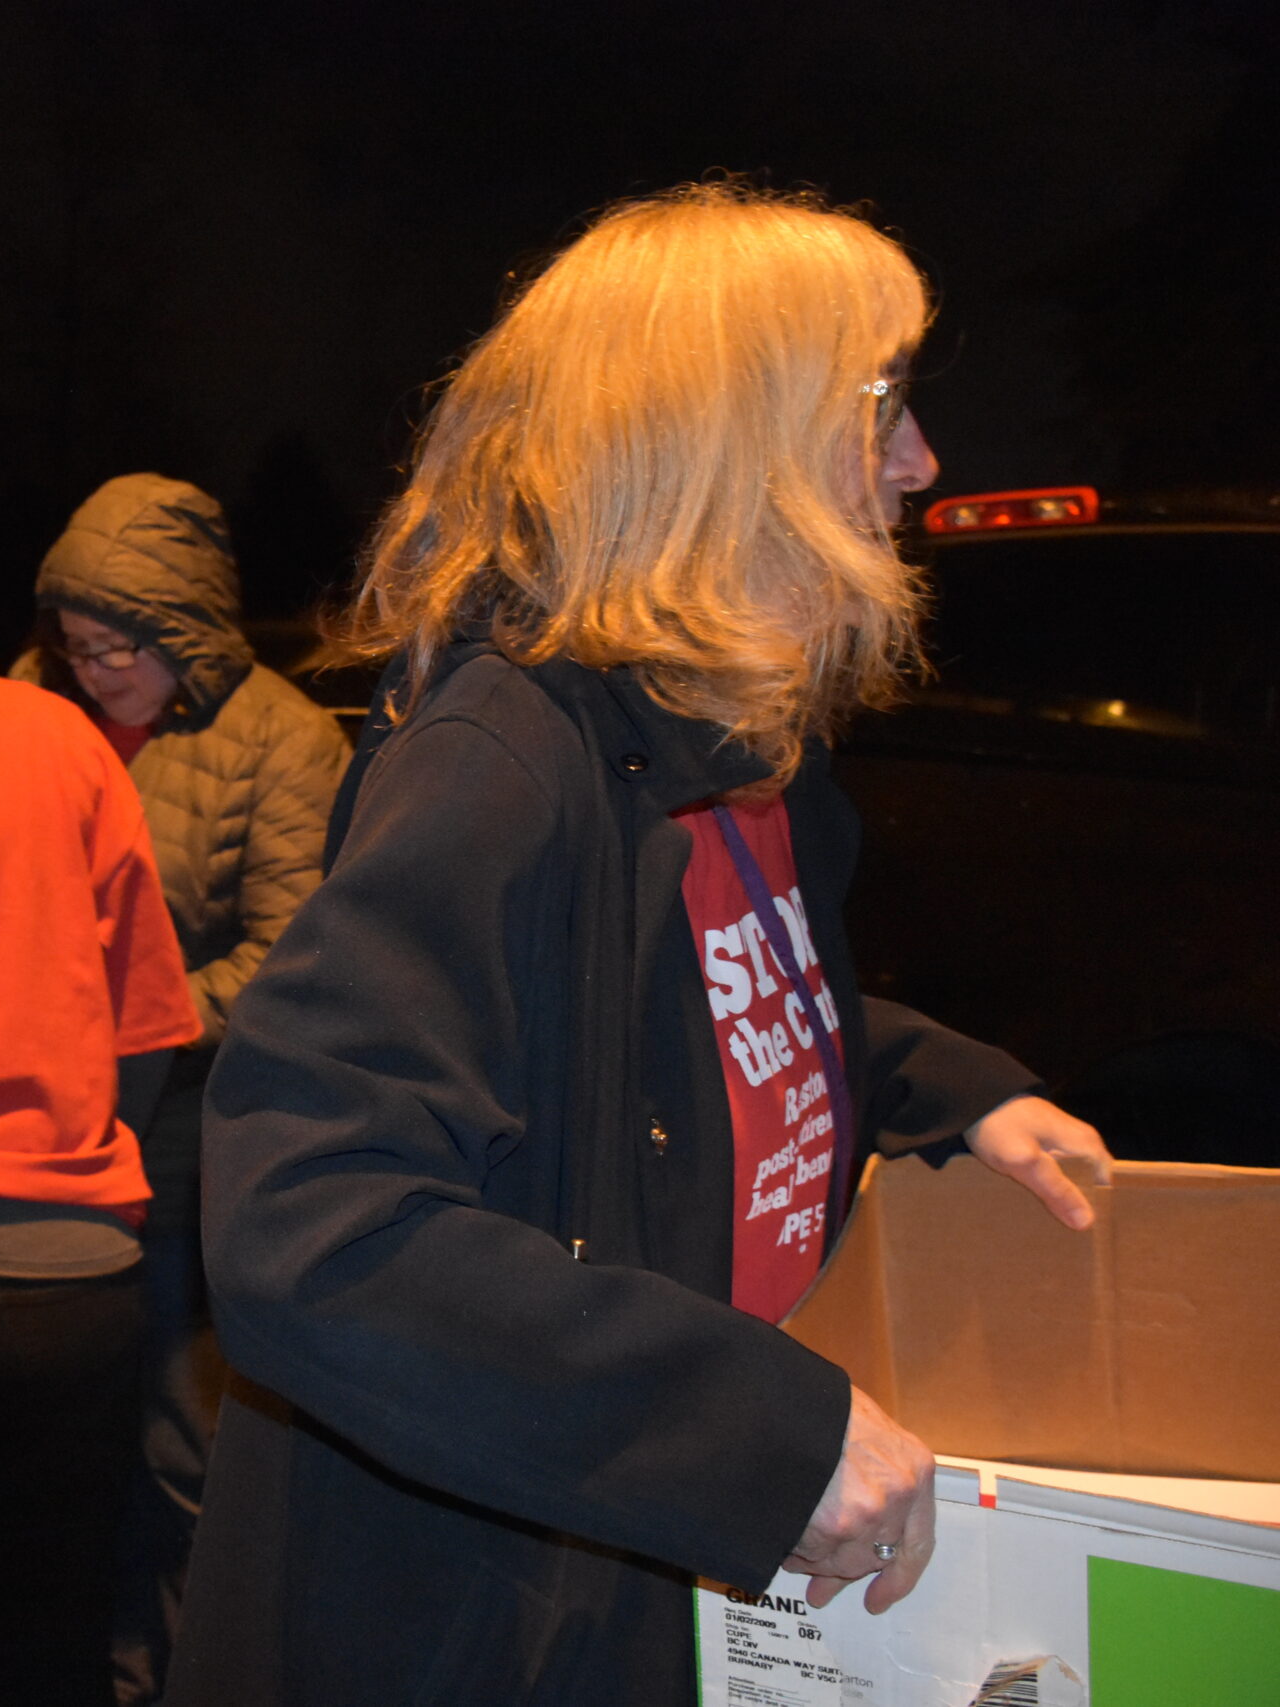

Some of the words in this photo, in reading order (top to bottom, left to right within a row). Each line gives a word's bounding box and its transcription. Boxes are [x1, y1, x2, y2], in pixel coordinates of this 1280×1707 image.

[728, 1017, 794, 1088] the
[798, 1627, 822, 1641] 087
[728, 1656, 774, 1671] BURNABY
[750, 1652, 791, 1666] CANADA
[793, 1660, 815, 1671] WAY
